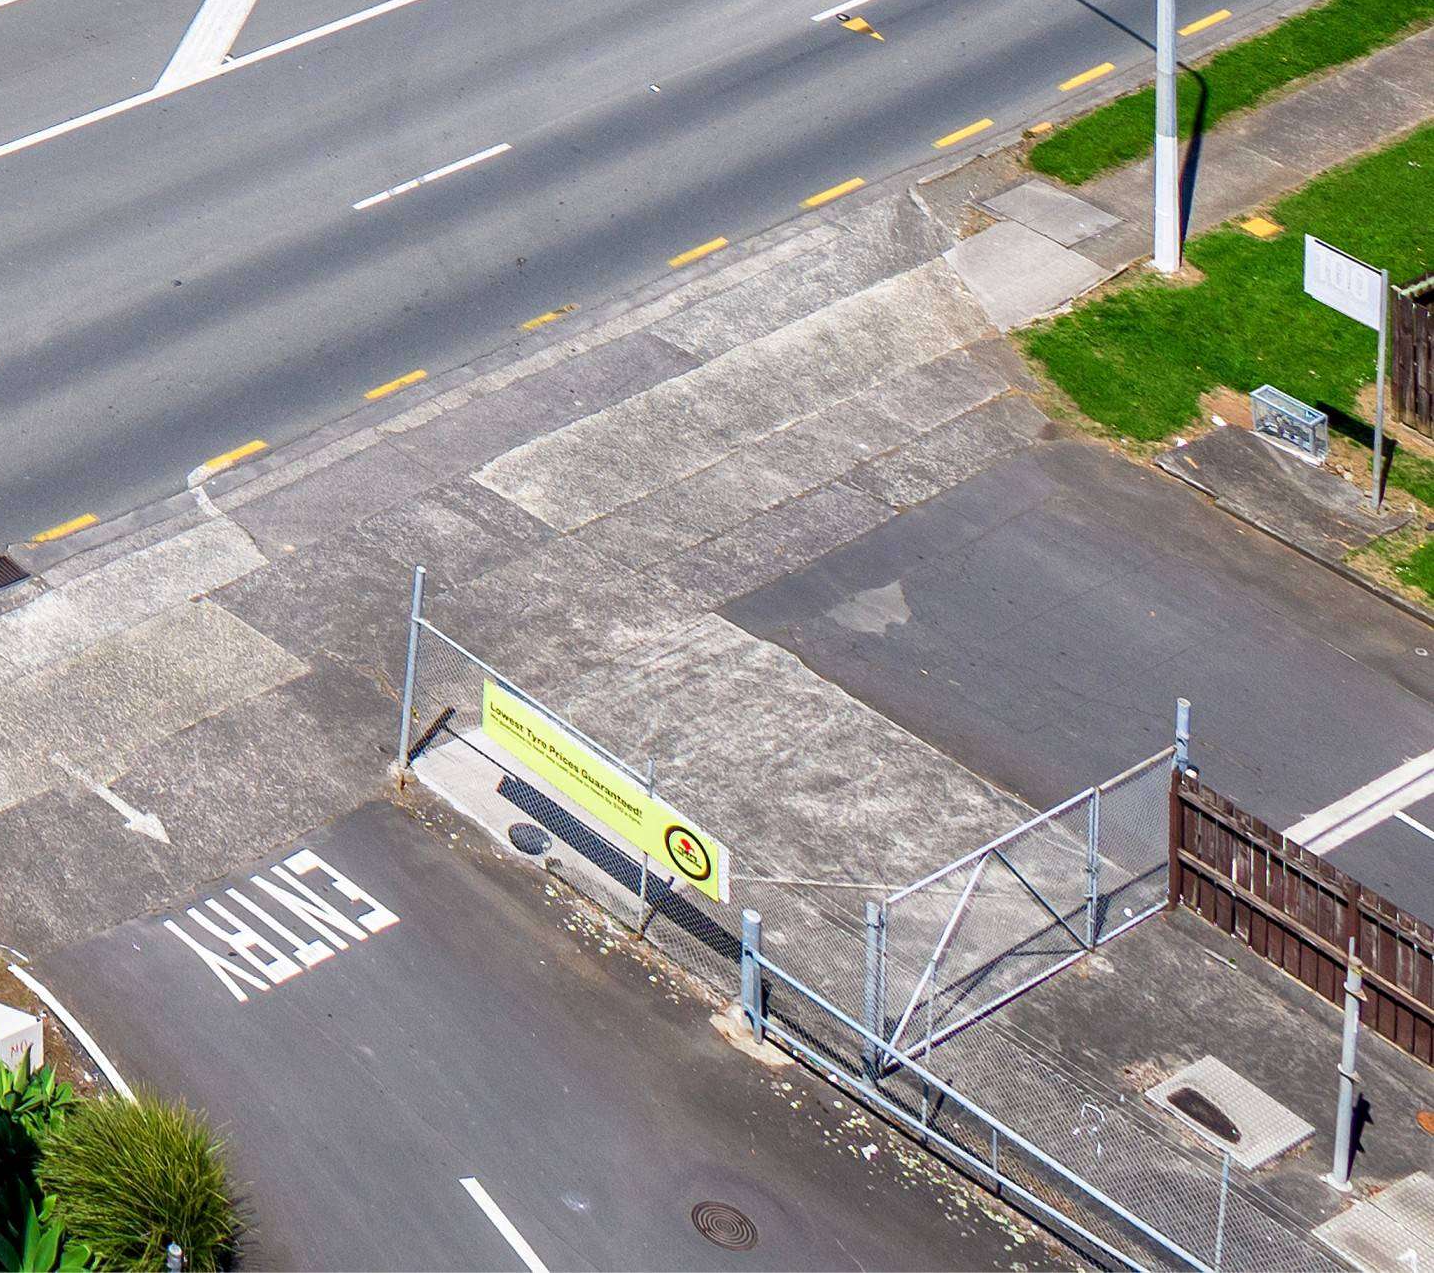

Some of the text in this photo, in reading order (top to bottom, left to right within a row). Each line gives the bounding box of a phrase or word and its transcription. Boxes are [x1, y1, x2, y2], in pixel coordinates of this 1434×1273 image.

[490, 701, 643, 817] Lowest Tyre Prices Guaranteed!
[163, 848, 401, 1004] ENTRY
